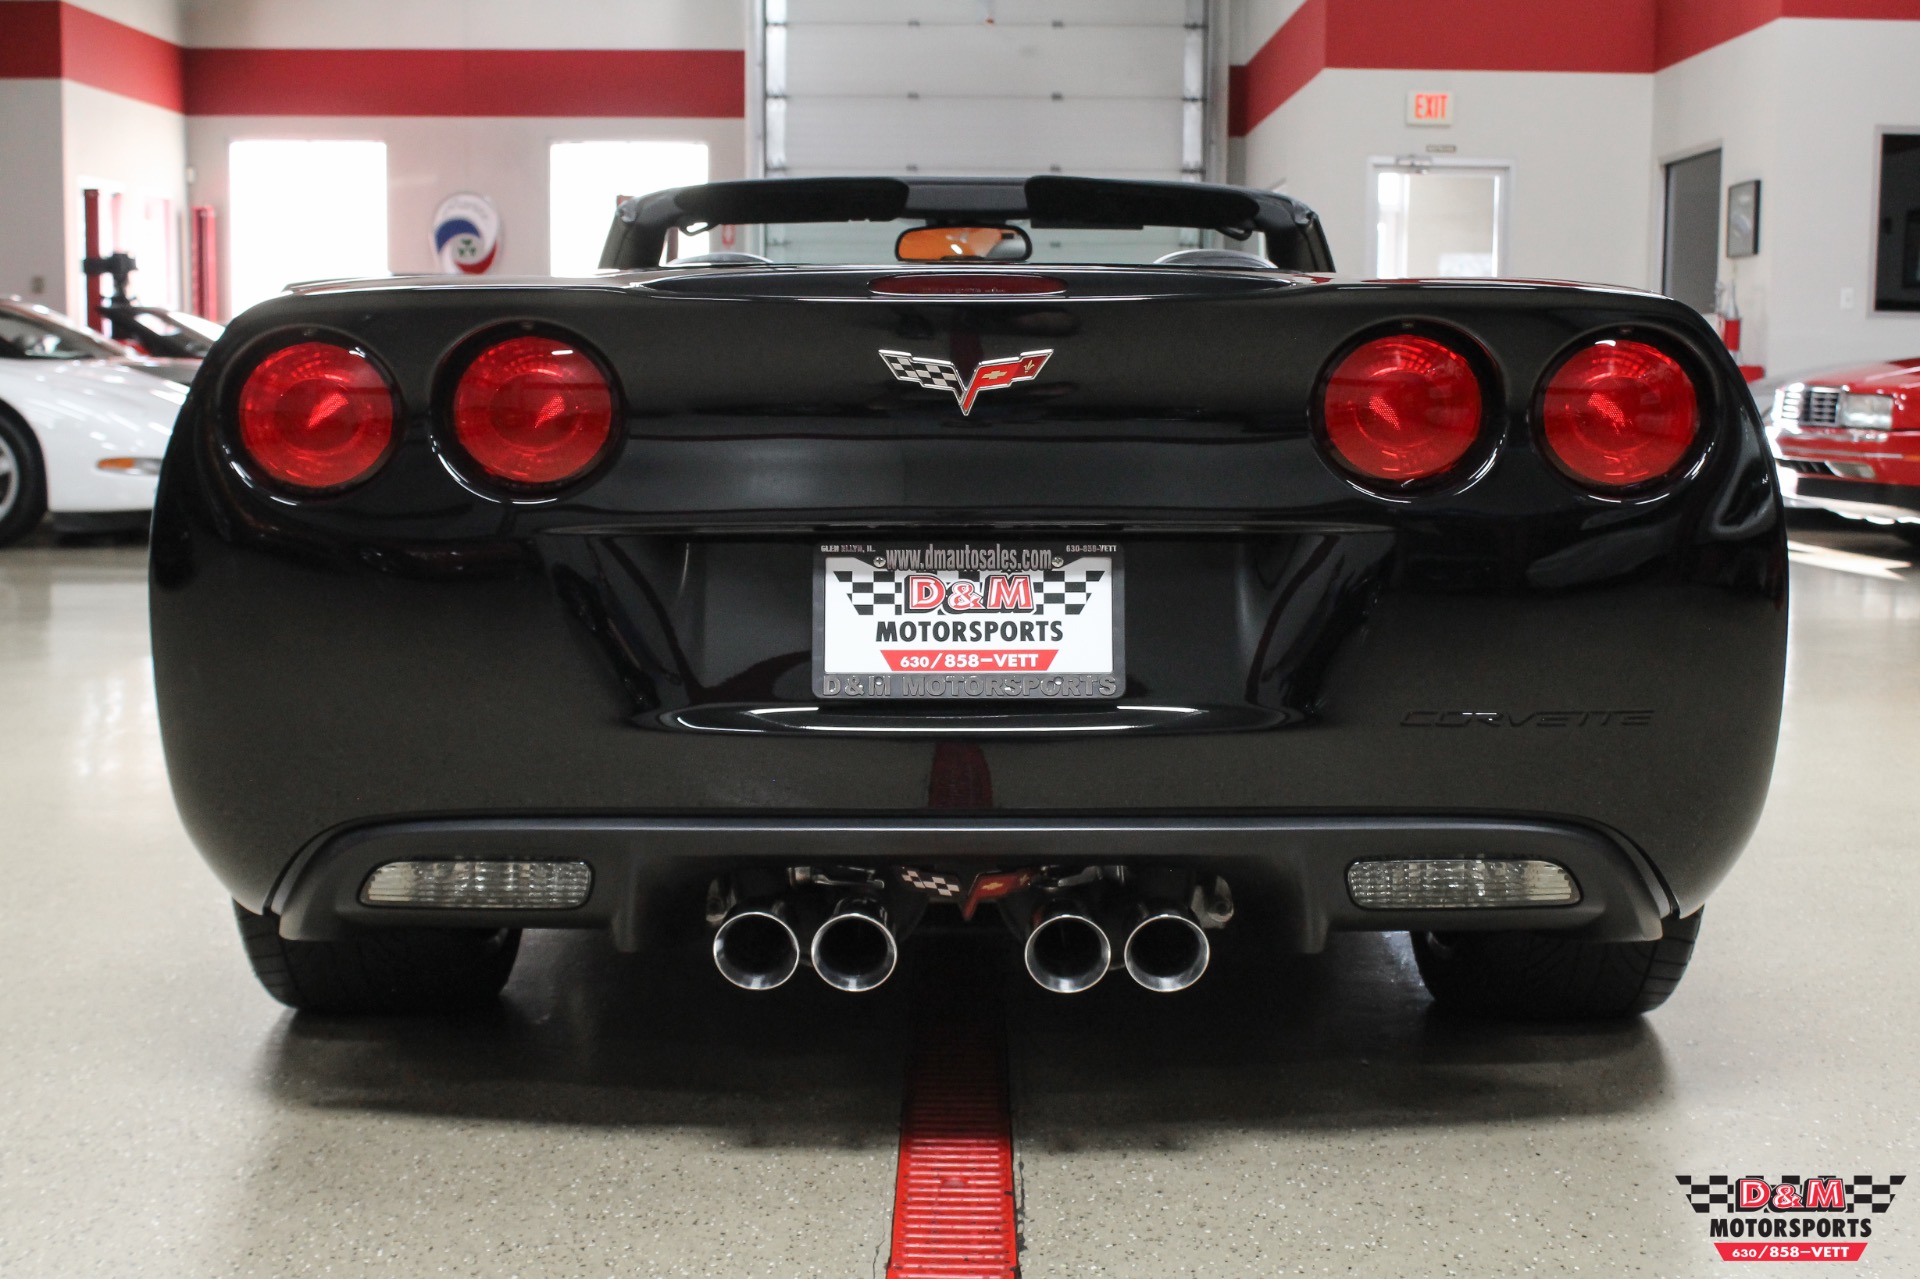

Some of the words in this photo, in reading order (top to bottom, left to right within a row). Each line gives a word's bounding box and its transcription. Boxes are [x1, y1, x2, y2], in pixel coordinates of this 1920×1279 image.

[1415, 94, 1448, 119] EXIT
[886, 544, 1051, 571] www.dmautosales.com
[904, 573, 1035, 613] D&M
[876, 620, 1063, 642] MOTORSPORTS
[900, 653, 1038, 668] 630/858-VETT
[823, 675, 891, 697] D&M
[902, 675, 1117, 697] MOTORSPORTS
[1400, 710, 1654, 727] CORVETTE
